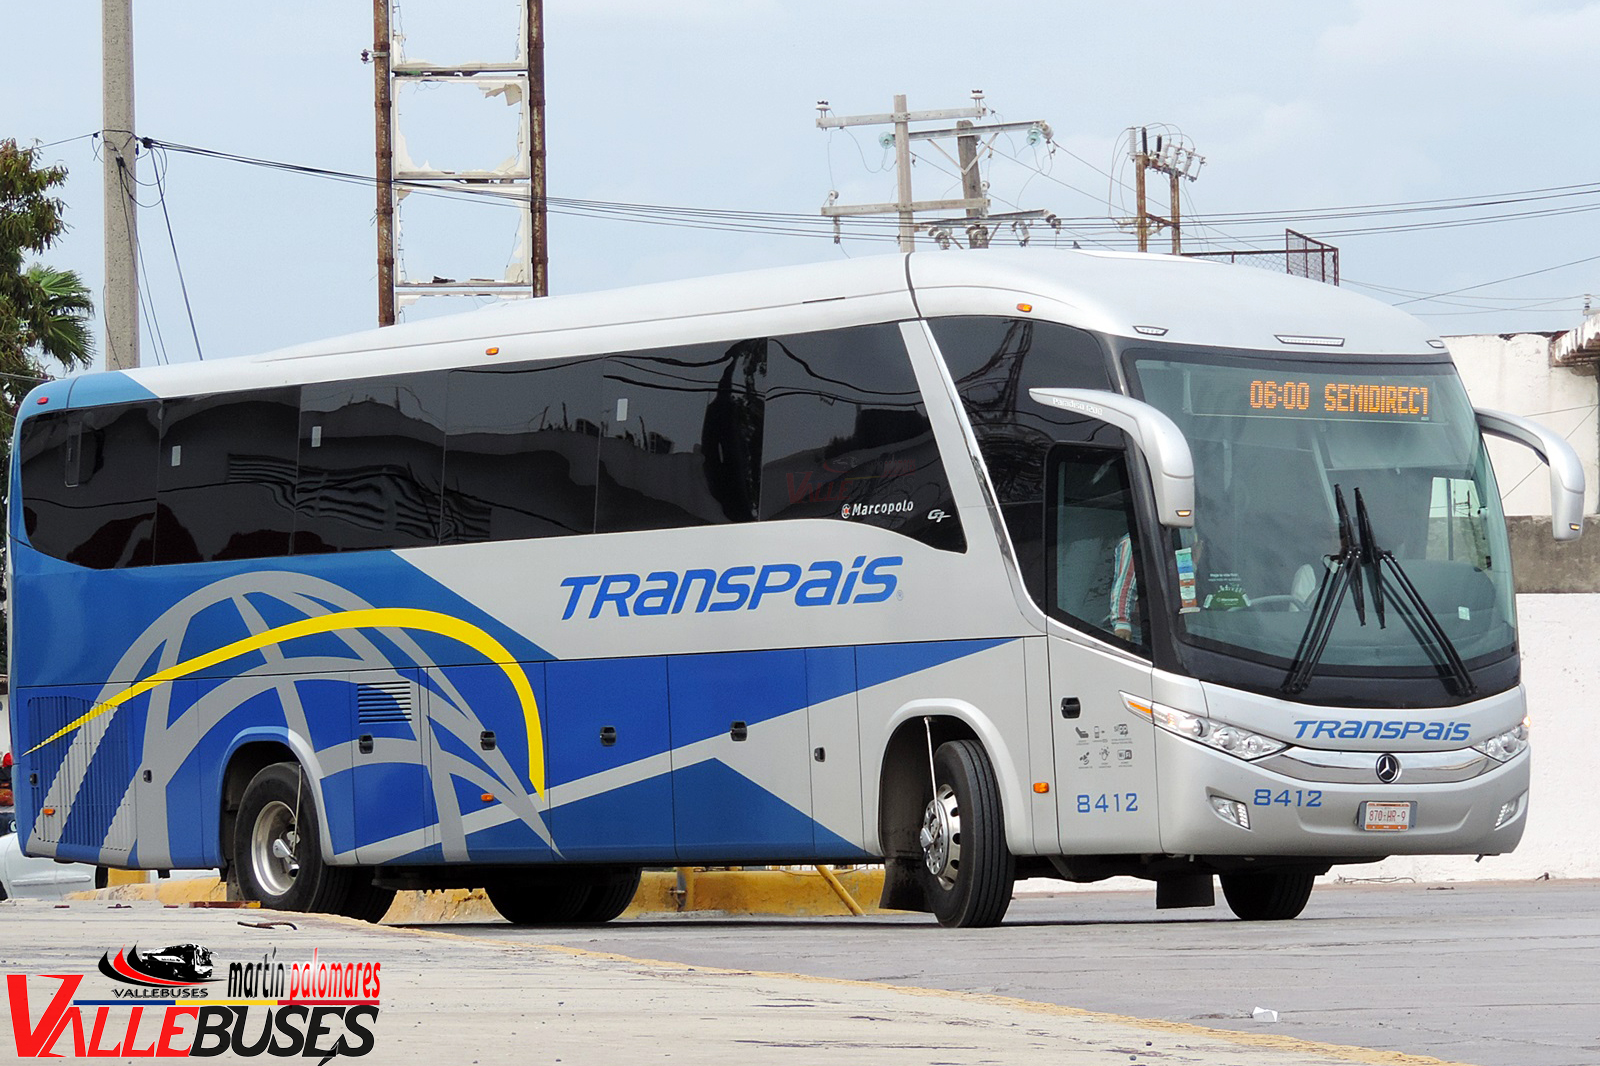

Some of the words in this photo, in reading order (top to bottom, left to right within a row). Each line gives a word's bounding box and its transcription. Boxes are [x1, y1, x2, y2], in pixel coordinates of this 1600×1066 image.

[1250, 380, 1310, 410] 06:00
[851, 499, 914, 517] Marcopolo
[1076, 792, 1139, 814] 8412
[1253, 788, 1323, 809] 8412
